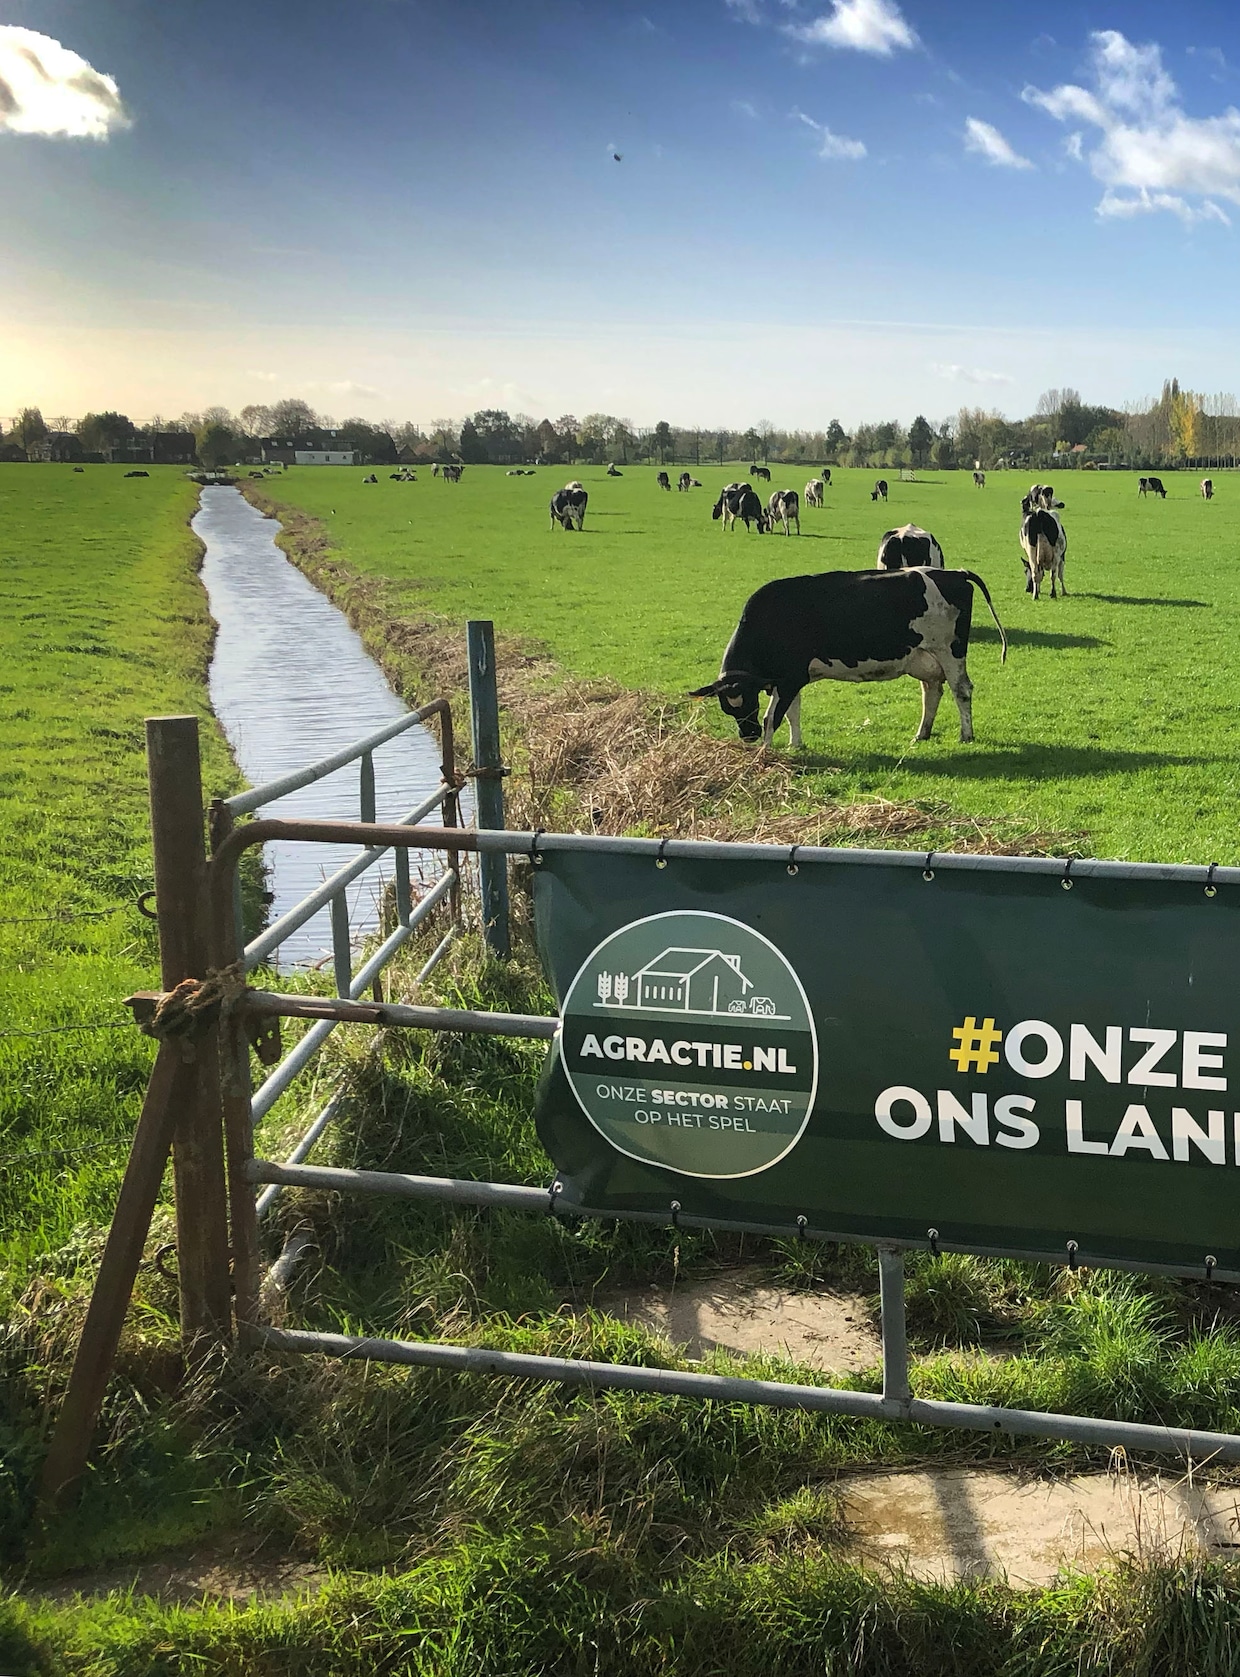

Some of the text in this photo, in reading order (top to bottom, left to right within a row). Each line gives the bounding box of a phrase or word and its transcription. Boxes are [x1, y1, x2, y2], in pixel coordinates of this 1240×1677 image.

[579, 1033, 797, 1074] AGRACTIE.NL
[949, 1015, 1228, 1092] #ONZE
[596, 1084, 792, 1115] ONZE SECTOR STAAT
[874, 1085, 1040, 1149] ONS
[634, 1109, 757, 1133] OP HET SPEL
